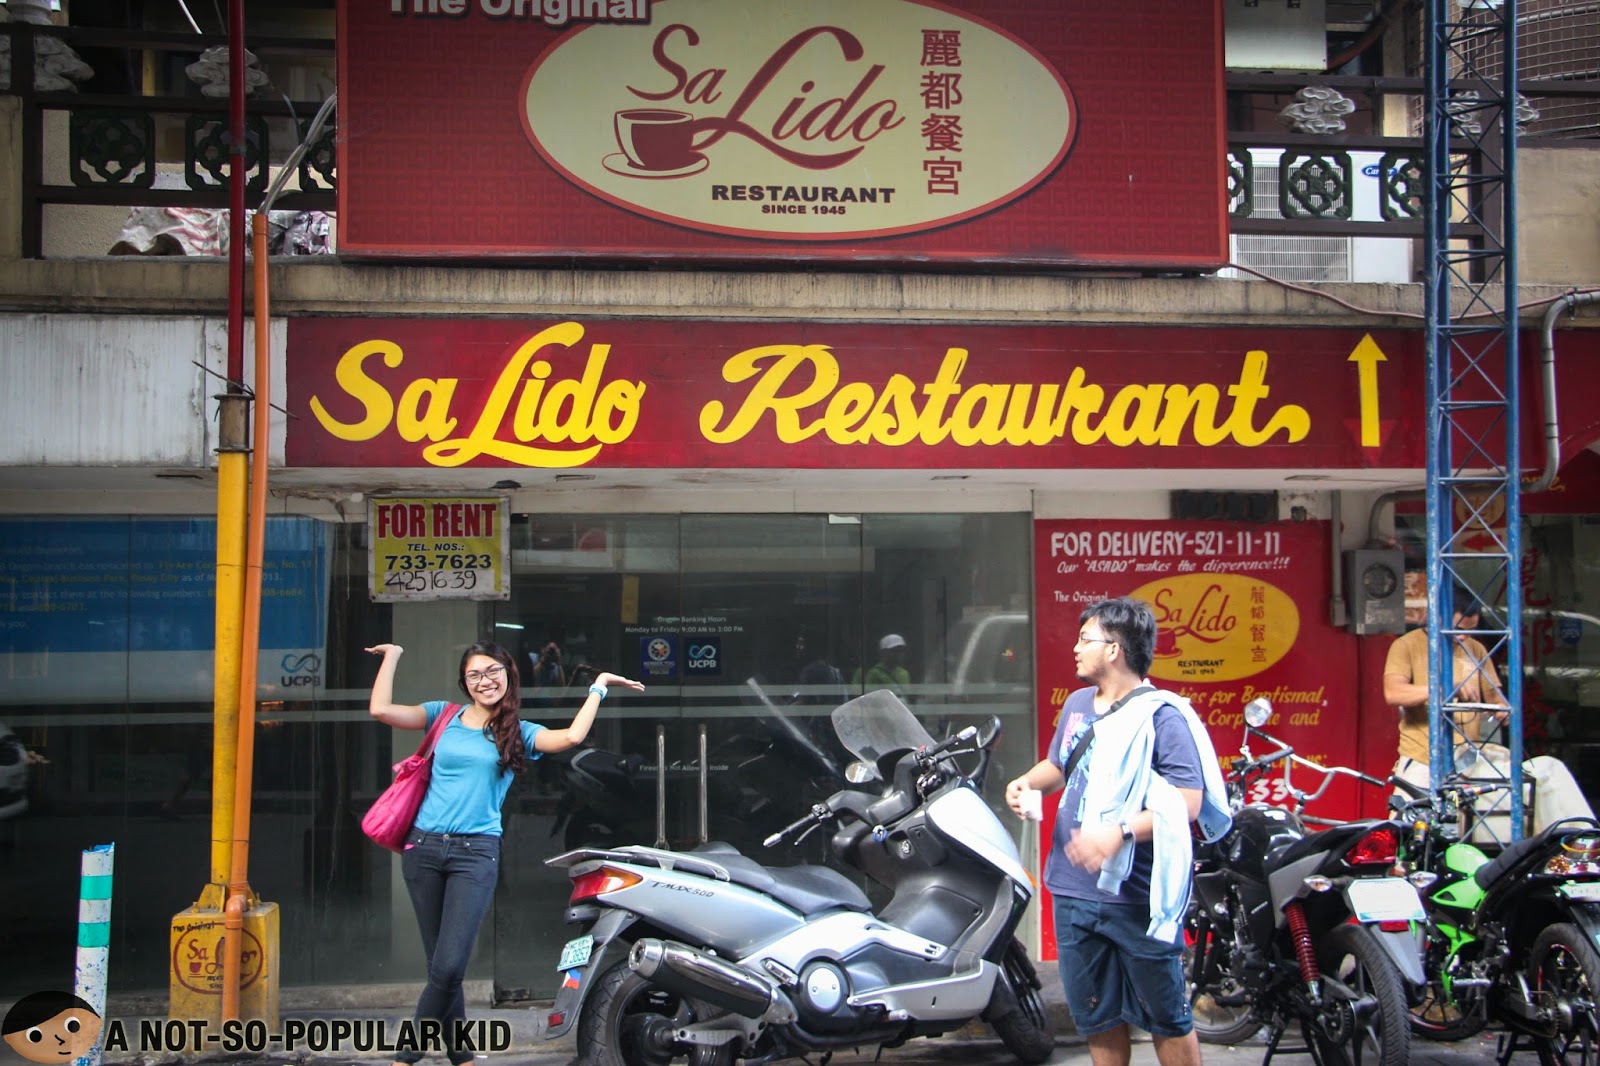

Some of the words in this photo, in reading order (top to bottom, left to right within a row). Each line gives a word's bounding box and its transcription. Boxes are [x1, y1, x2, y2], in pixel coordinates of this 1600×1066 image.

[627, 24, 727, 105] Sa
[692, 26, 905, 171] Lido
[919, 29, 963, 196] 麗都餐宮
[711, 184, 896, 205] RESTAURANT
[761, 204, 807, 216] SINCE
[811, 205, 847, 216] 1945
[309, 339, 458, 442] Sa
[422, 321, 647, 468] Lido
[700, 344, 1312, 447] Restaurant
[378, 504, 426, 538] FOR
[432, 503, 497, 538] RENT
[407, 543, 430, 552] TEL.
[434, 543, 465, 552] NOS.:
[1051, 532, 1092, 557] FOR
[385, 554, 492, 571] 733-7623
[1057, 561, 1078, 573] Our
[1135, 560, 1171, 573] makes
[1178, 558, 1197, 572] the
[194, 573, 204, 582] of
[1054, 591, 1071, 603] The
[1073, 590, 1109, 603] Original
[681, 616, 706, 624] Banking
[1154, 588, 1182, 623] Sa
[1175, 584, 1237, 643] Lido
[625, 626, 650, 634] Monday
[660, 626, 680, 634] Friday
[688, 660, 718, 668] UCPB
[281, 675, 321, 687] UCPB
[1209, 690, 1236, 710] for
[1289, 708, 1320, 727] and
[187, 938, 209, 961] Sa
